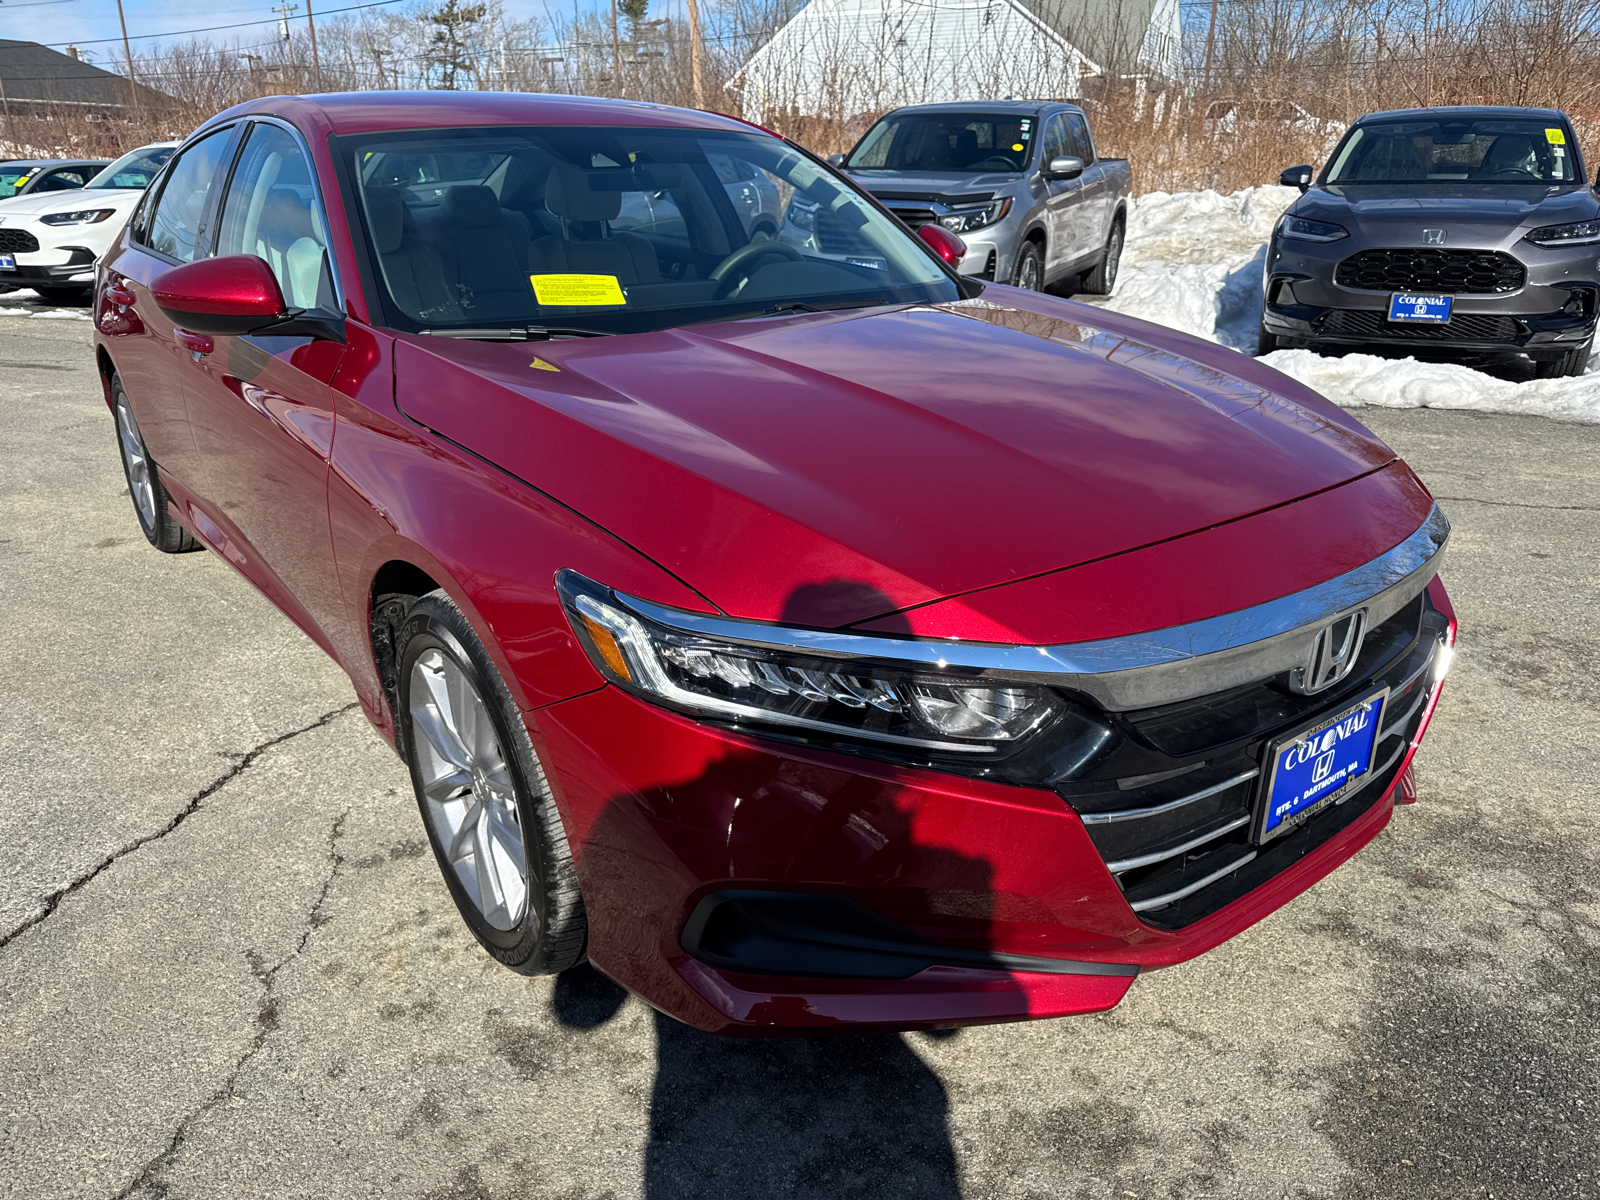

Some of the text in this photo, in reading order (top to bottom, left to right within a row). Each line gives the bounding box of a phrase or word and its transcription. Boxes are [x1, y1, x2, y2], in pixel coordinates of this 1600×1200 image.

[1398, 296, 1446, 306] COLONIAL
[1284, 711, 1369, 771] COLONIAL
[1275, 800, 1293, 817] RTE.
[1293, 796, 1299, 806] 6
[1347, 760, 1359, 773] MA
